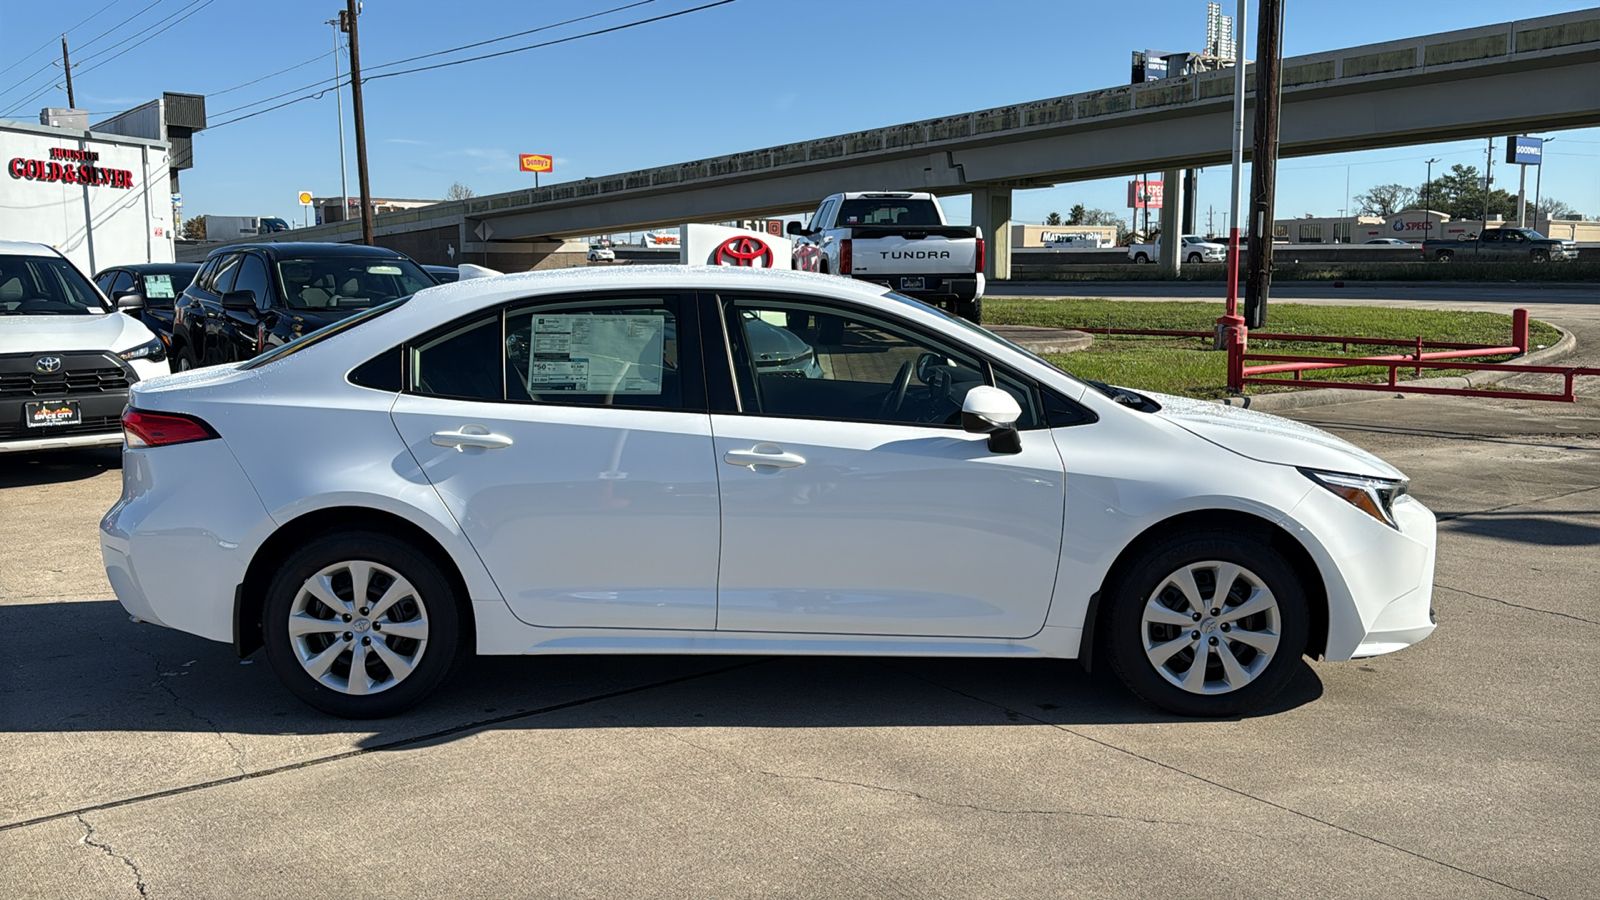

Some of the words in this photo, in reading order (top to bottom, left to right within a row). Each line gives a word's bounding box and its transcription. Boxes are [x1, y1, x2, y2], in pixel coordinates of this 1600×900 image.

[50, 147, 99, 162] HOUSTON
[1516, 145, 1541, 156] GOODWILL
[525, 158, 549, 168] Denny's
[9, 157, 64, 182] GOLD
[78, 164, 134, 188] SILVER
[880, 251, 950, 259] TUNDRA
[34, 412, 56, 420] SPACE
